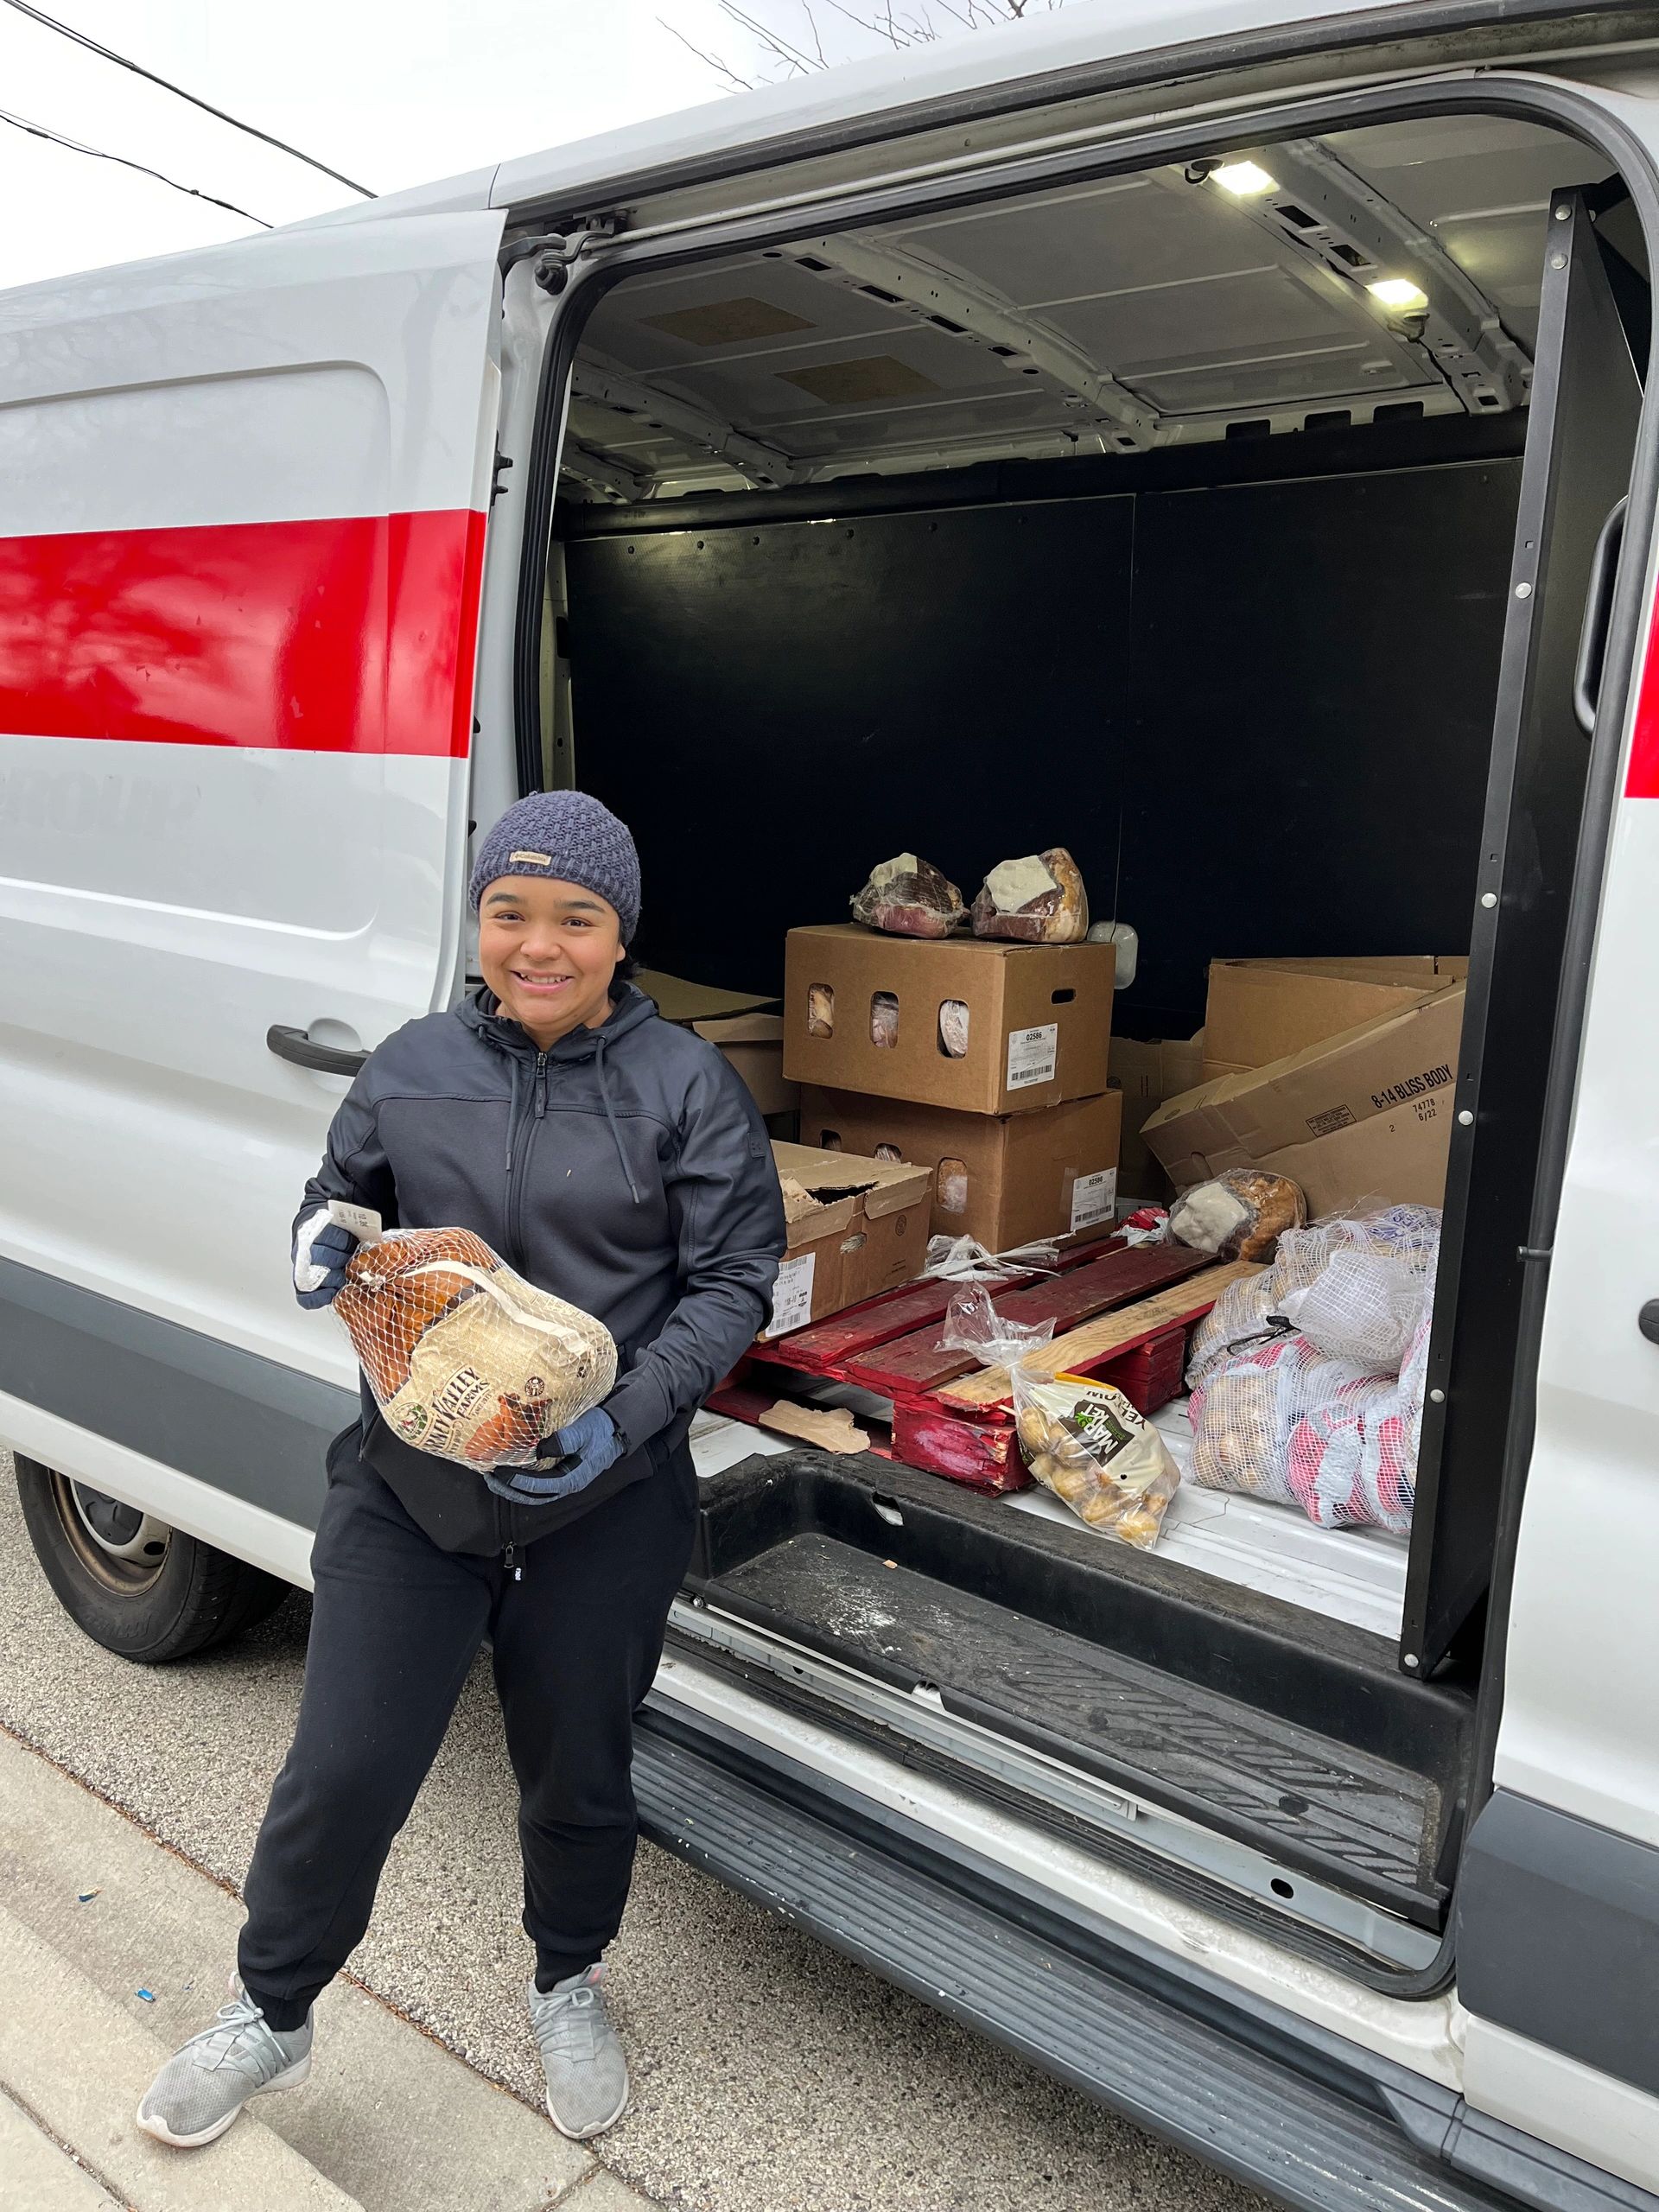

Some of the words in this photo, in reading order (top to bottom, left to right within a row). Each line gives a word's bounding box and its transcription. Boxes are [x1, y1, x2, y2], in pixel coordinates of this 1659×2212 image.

[1026, 1031, 1043, 1041] 02586
[1371, 1089, 1397, 1109] 8-14
[1394, 1076, 1426, 1100] BLISS
[1422, 1064, 1453, 1088] BODY
[1413, 1098, 1435, 1113] 74778
[1418, 1109, 1437, 1122] 6/22
[432, 1367, 480, 1420] VALLEY
[457, 1378, 490, 1420] FARMS
[1086, 1390, 1147, 1431] YELOW
